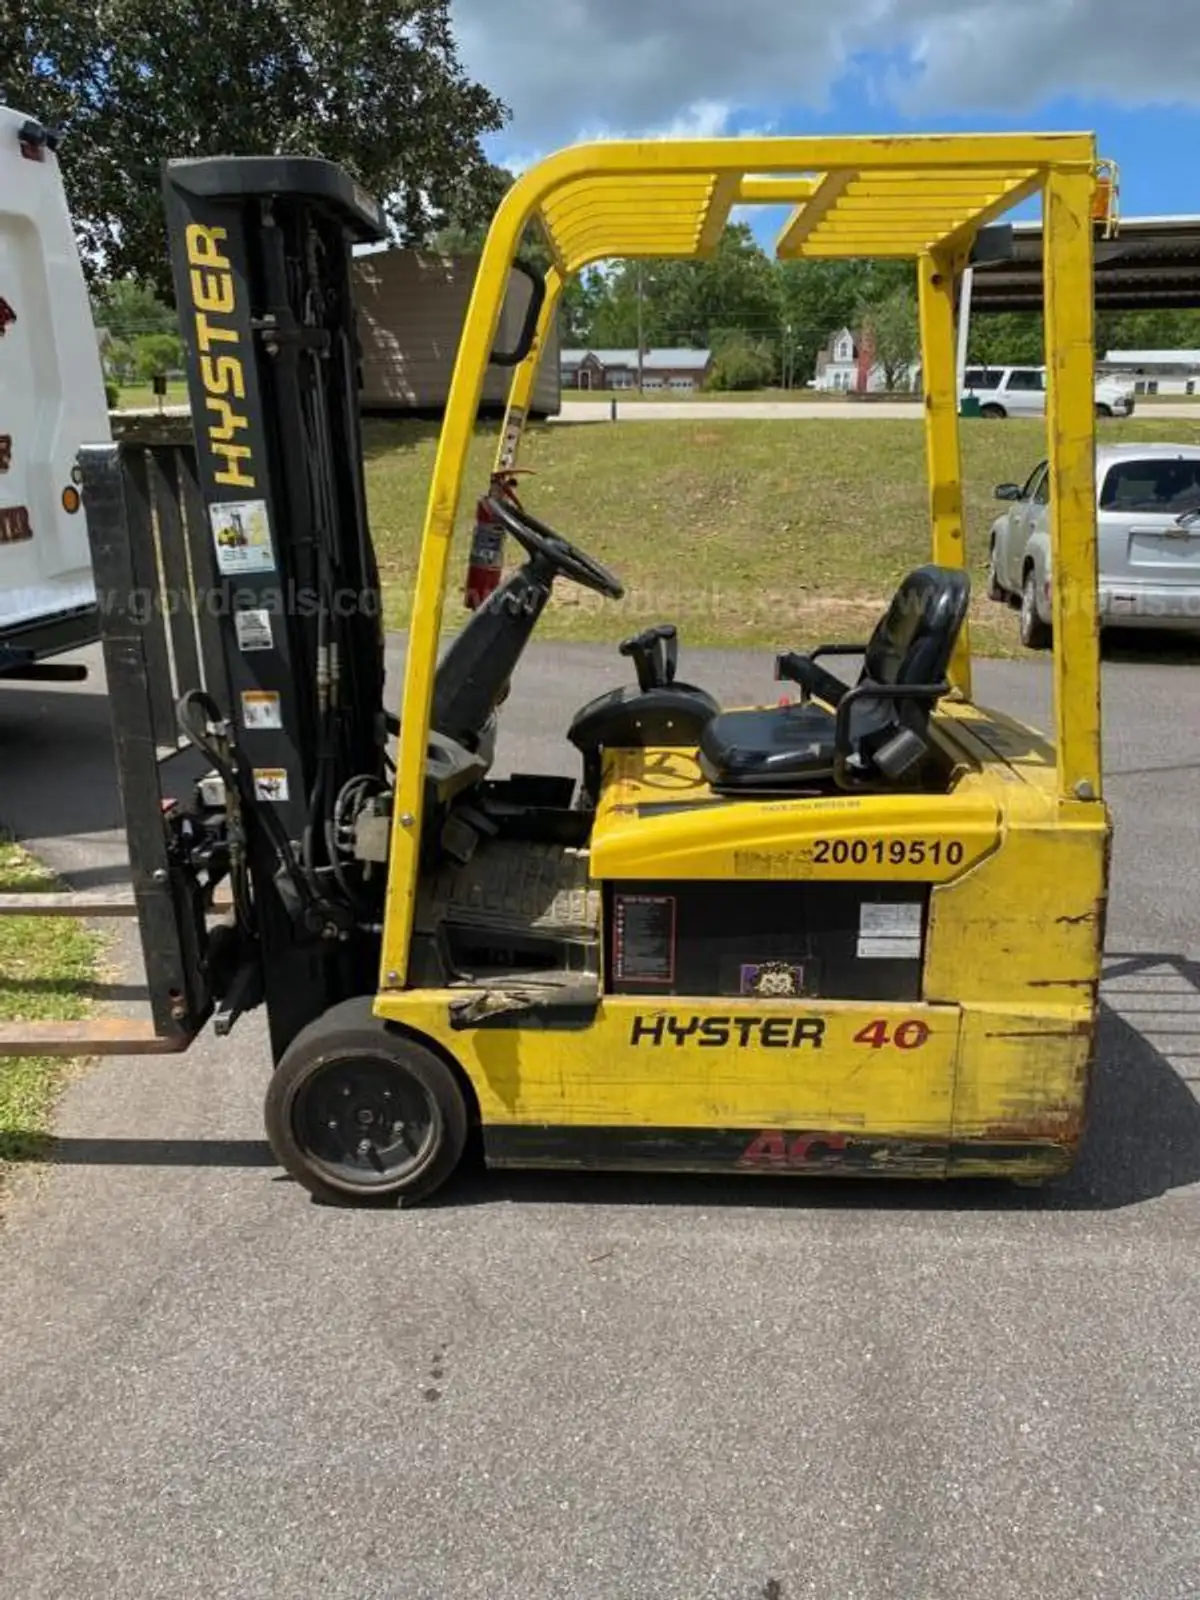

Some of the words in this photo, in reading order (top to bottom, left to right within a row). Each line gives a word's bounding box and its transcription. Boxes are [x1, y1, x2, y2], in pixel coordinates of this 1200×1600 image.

[186, 223, 255, 487] HYSTER
[813, 840, 963, 865] 20019510
[631, 1016, 825, 1048] HYSTER
[853, 1019, 930, 1049] 40
